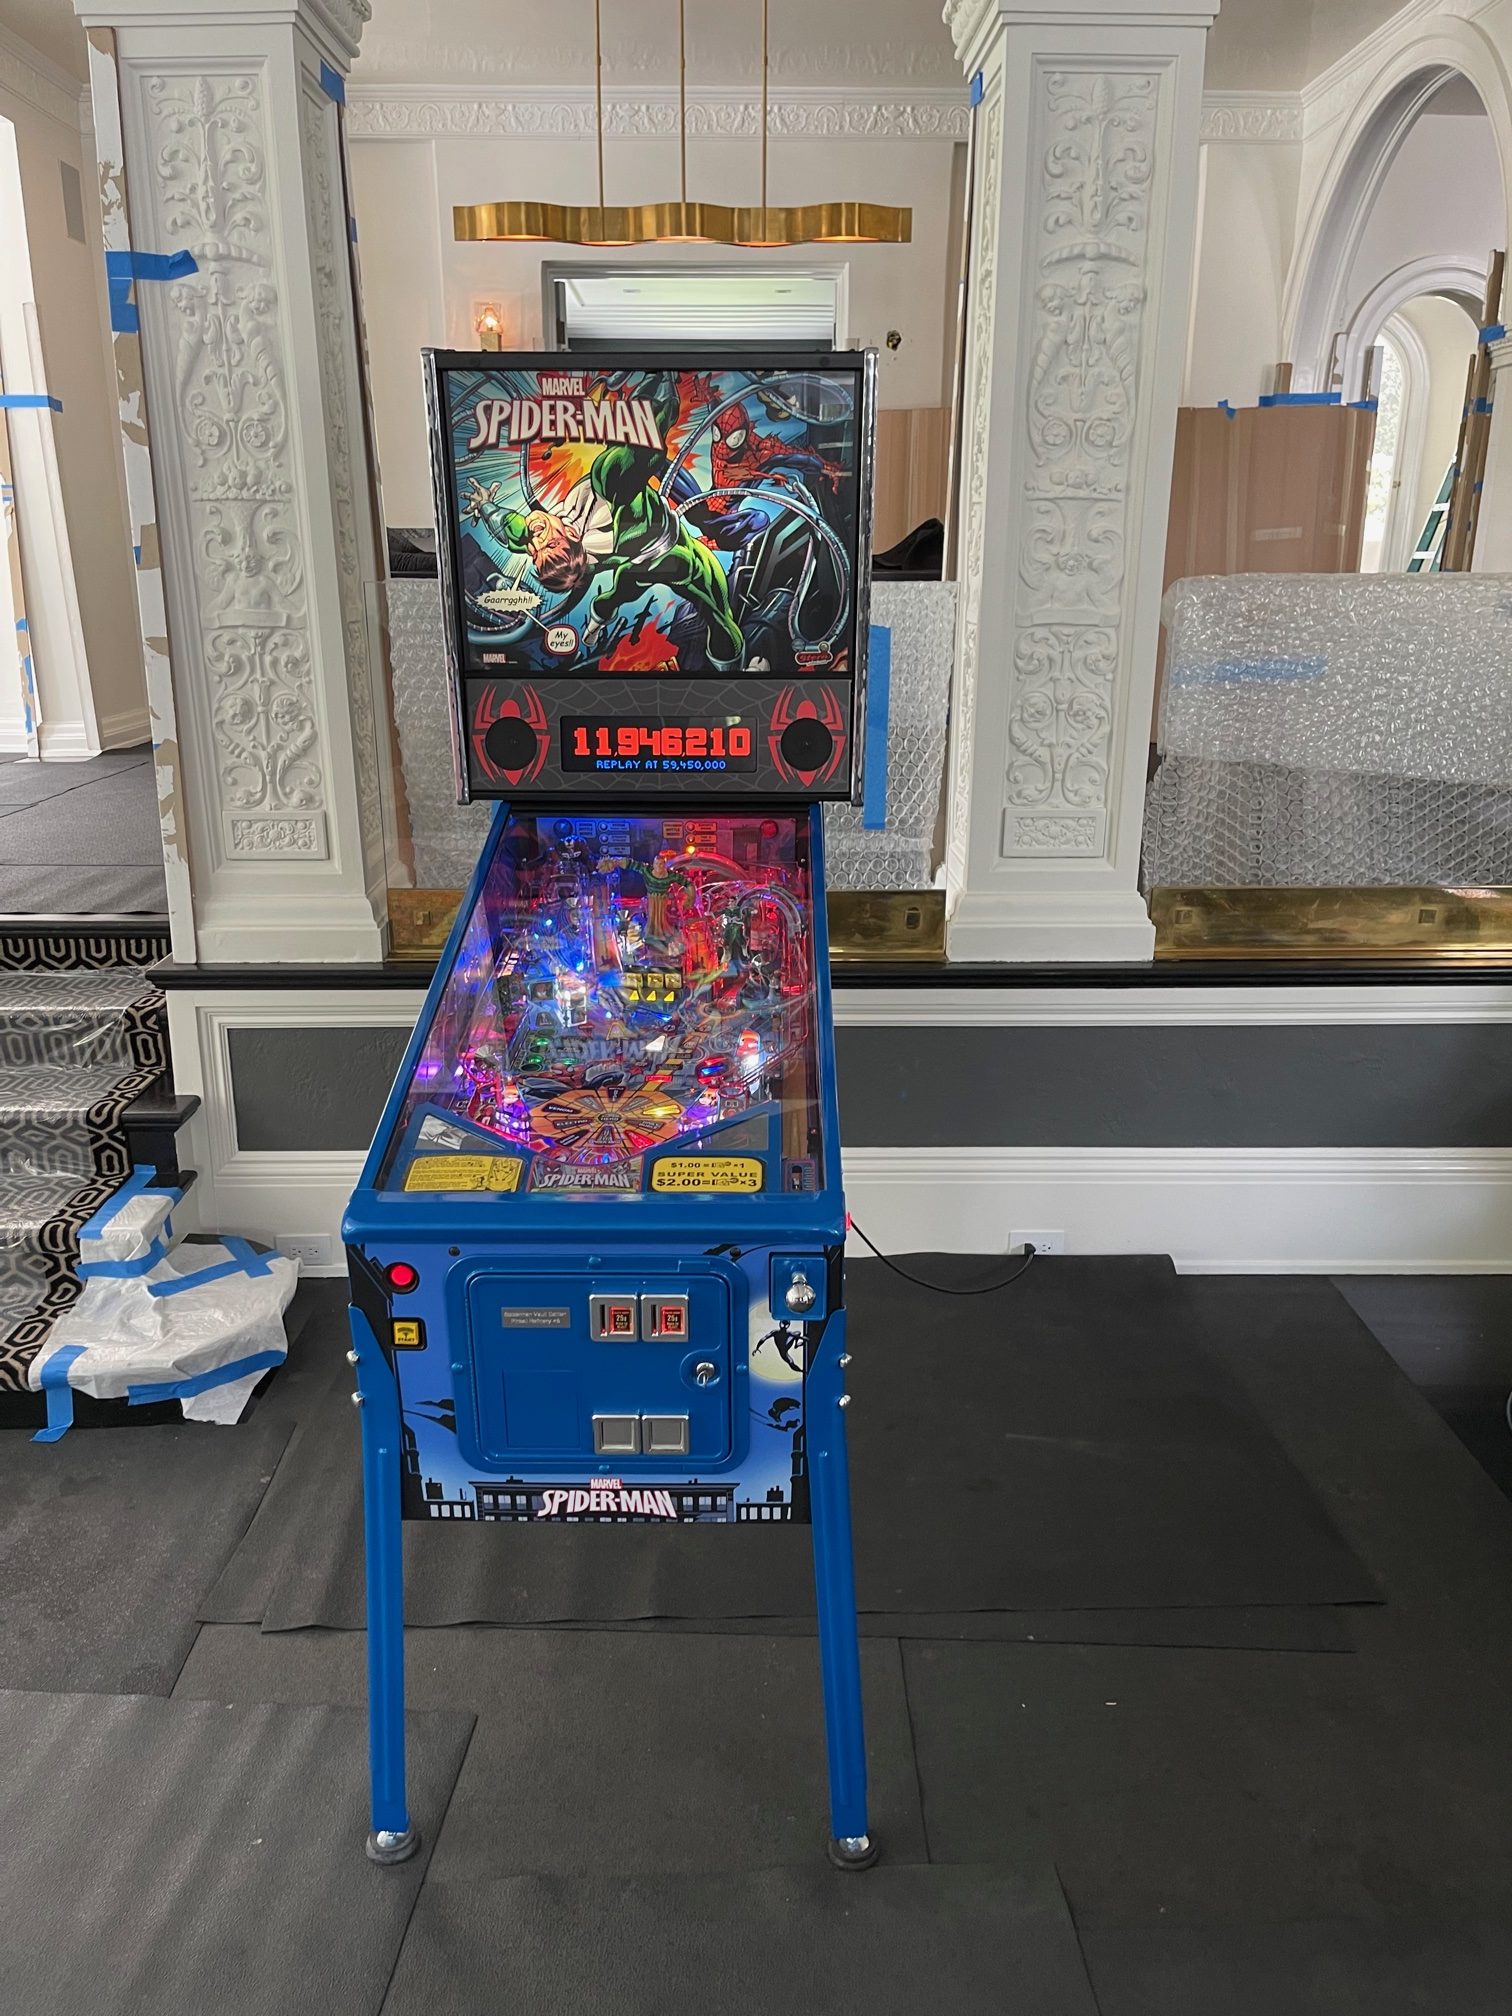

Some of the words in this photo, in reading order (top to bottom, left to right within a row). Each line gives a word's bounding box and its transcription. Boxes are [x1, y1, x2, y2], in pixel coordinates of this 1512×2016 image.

[542, 377, 585, 396] MARVEL
[468, 400, 665, 450] SPIDER-MAN
[554, 631, 568, 640] My
[482, 653, 506, 664] MARVEL
[573, 727, 751, 757] 11,946,210
[596, 760, 641, 770] REPLAY
[645, 760, 658, 770] AT
[662, 760, 726, 771] 59,450,000
[548, 1105, 574, 1114] VENOM
[556, 1119, 589, 1127] ELECTRO
[539, 1174, 630, 1188] SPIDER-MAN
[590, 1478, 621, 1490] MARVEL
[537, 1489, 678, 1519] SPIDER-MAN
